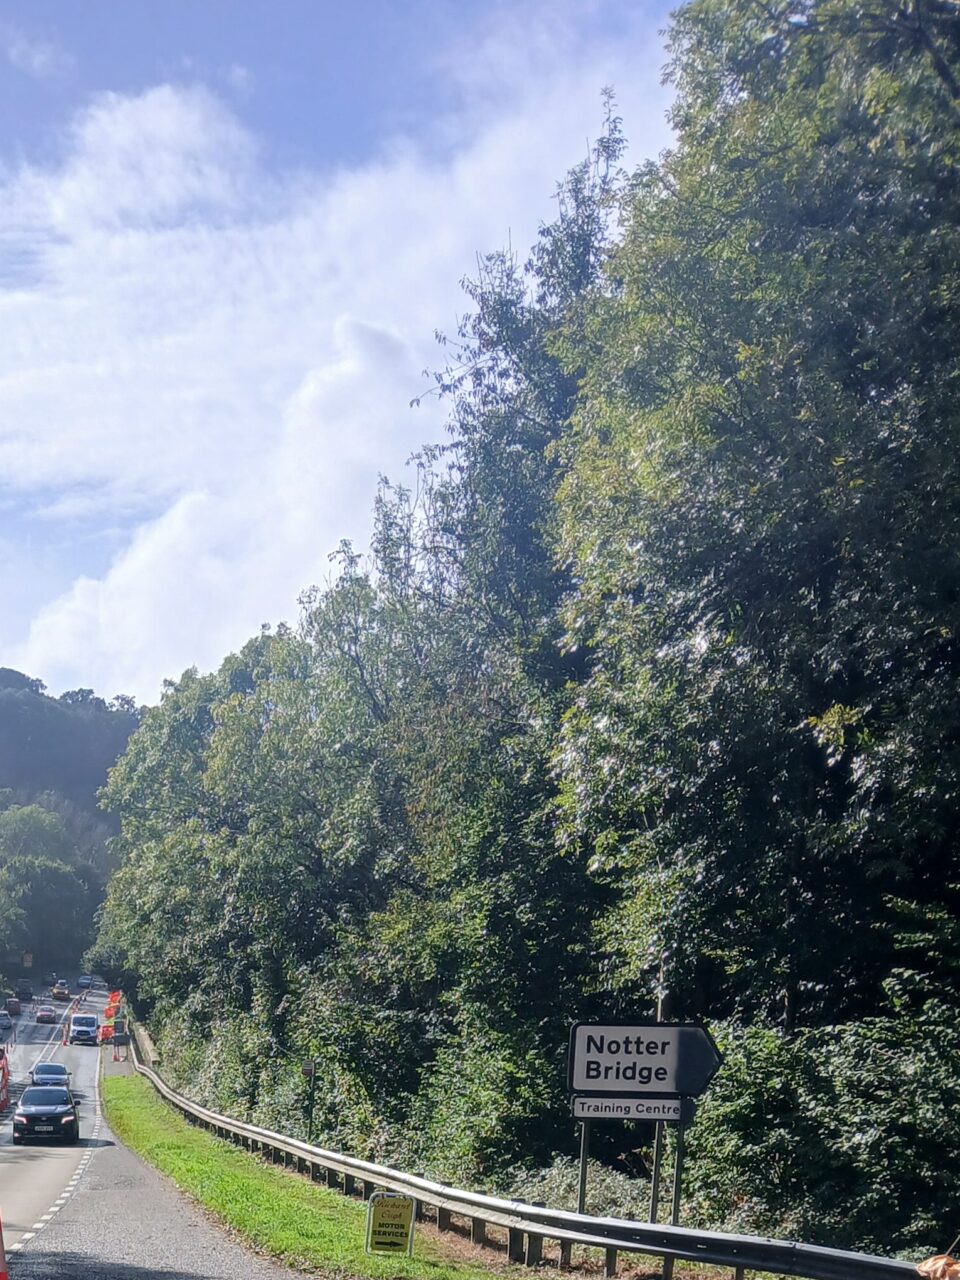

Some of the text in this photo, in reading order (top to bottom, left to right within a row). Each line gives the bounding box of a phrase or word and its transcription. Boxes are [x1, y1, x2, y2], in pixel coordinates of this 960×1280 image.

[586, 1035, 671, 1055] Notter
[585, 1060, 668, 1084] Bridge
[579, 1102, 680, 1115] Training Centre
[378, 1222, 405, 1230] MOTOR
[372, 1230, 409, 1238] SERVICES
